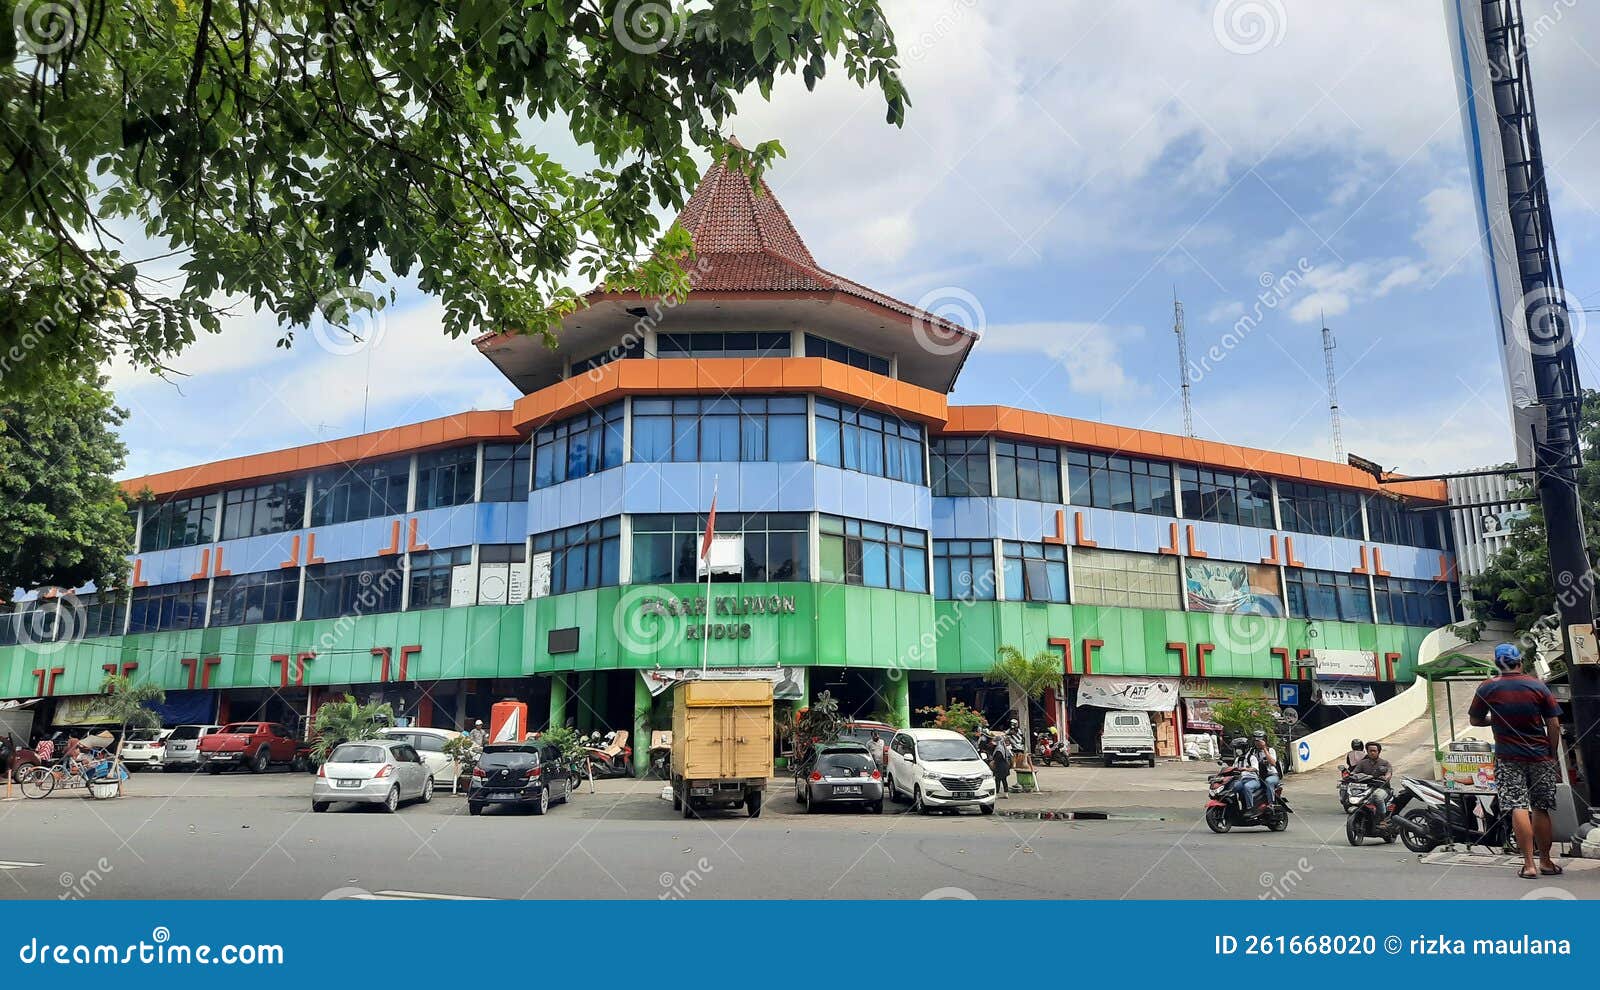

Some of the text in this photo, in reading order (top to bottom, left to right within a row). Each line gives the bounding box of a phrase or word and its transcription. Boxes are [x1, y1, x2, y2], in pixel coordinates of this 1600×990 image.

[715, 595, 796, 617] KLIWON
[687, 623, 752, 641] KUDUS
[1282, 687, 1296, 702] P
